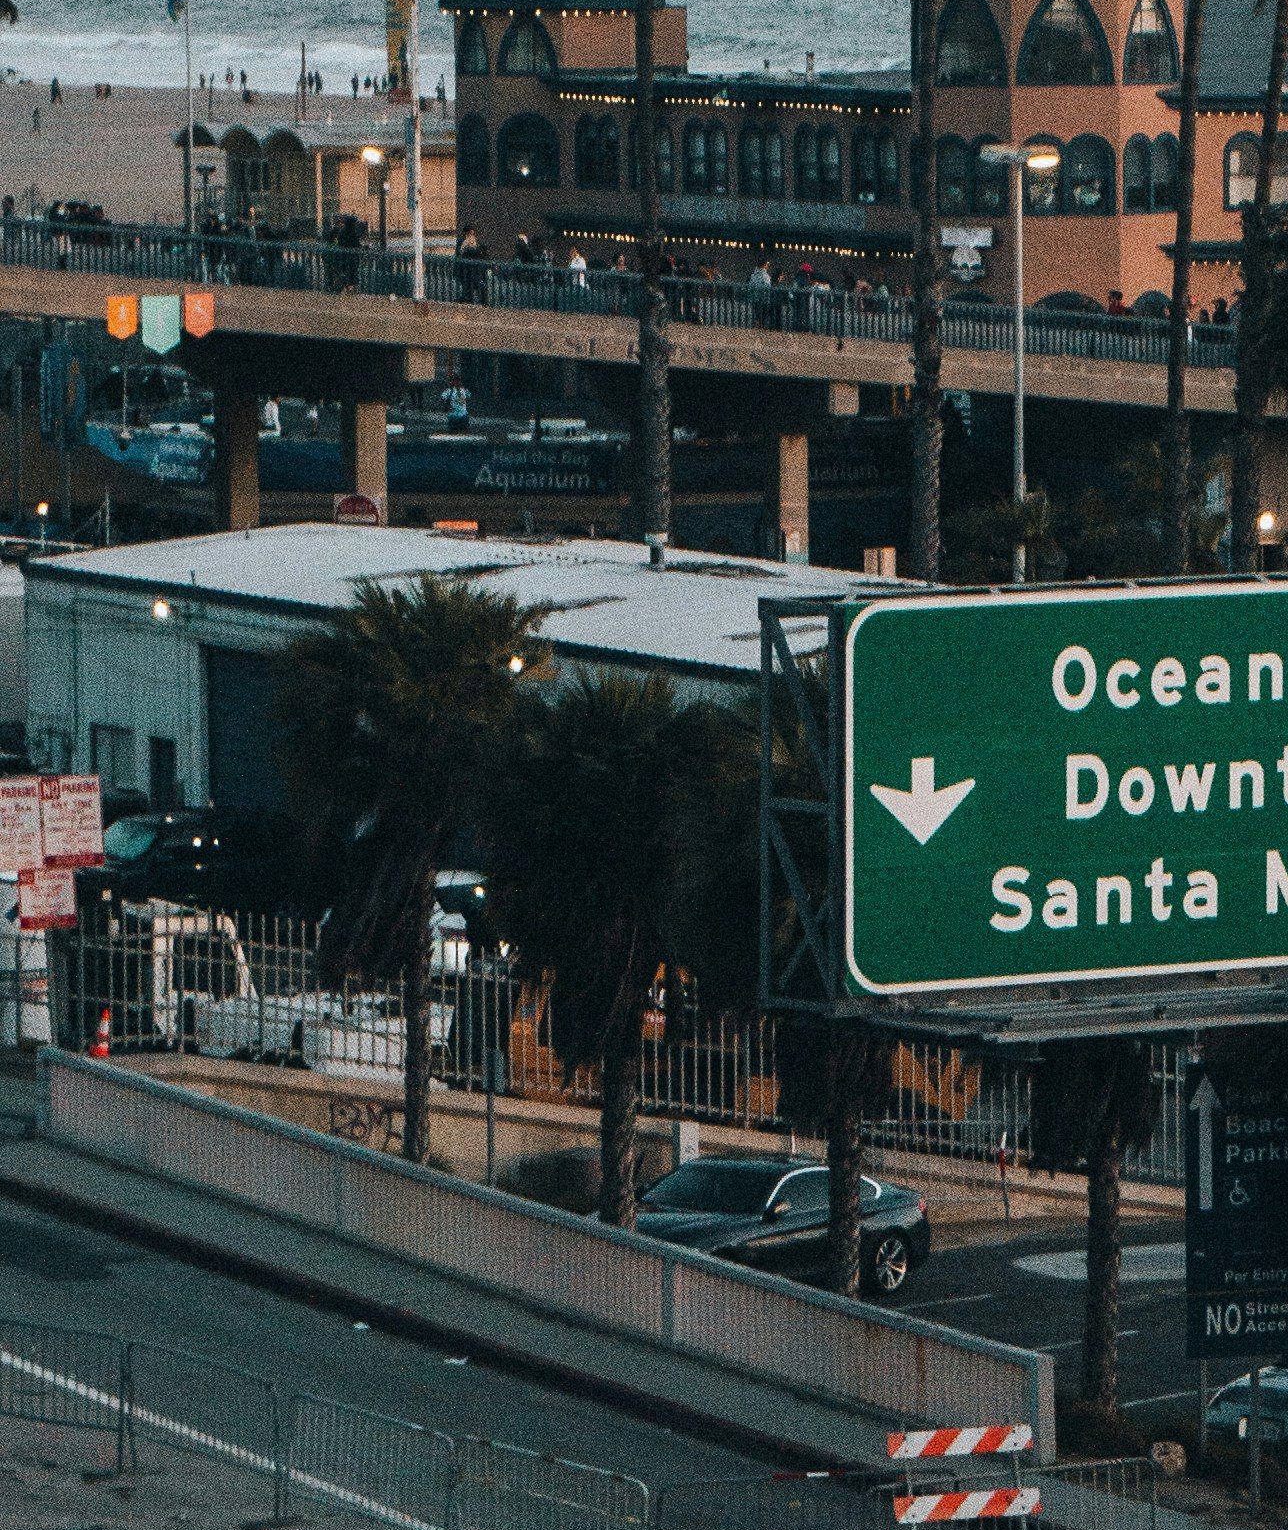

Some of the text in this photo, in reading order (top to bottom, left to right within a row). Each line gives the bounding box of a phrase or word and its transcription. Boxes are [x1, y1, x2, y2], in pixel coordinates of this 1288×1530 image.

[492, 450, 591, 467] Heal the Bay
[474, 464, 590, 496] Aquarium
[1052, 645, 1284, 711] Ocean
[989, 857, 1218, 932] Santa
[1223, 1269, 1249, 1284] Per
[1205, 1302, 1242, 1337] NO
